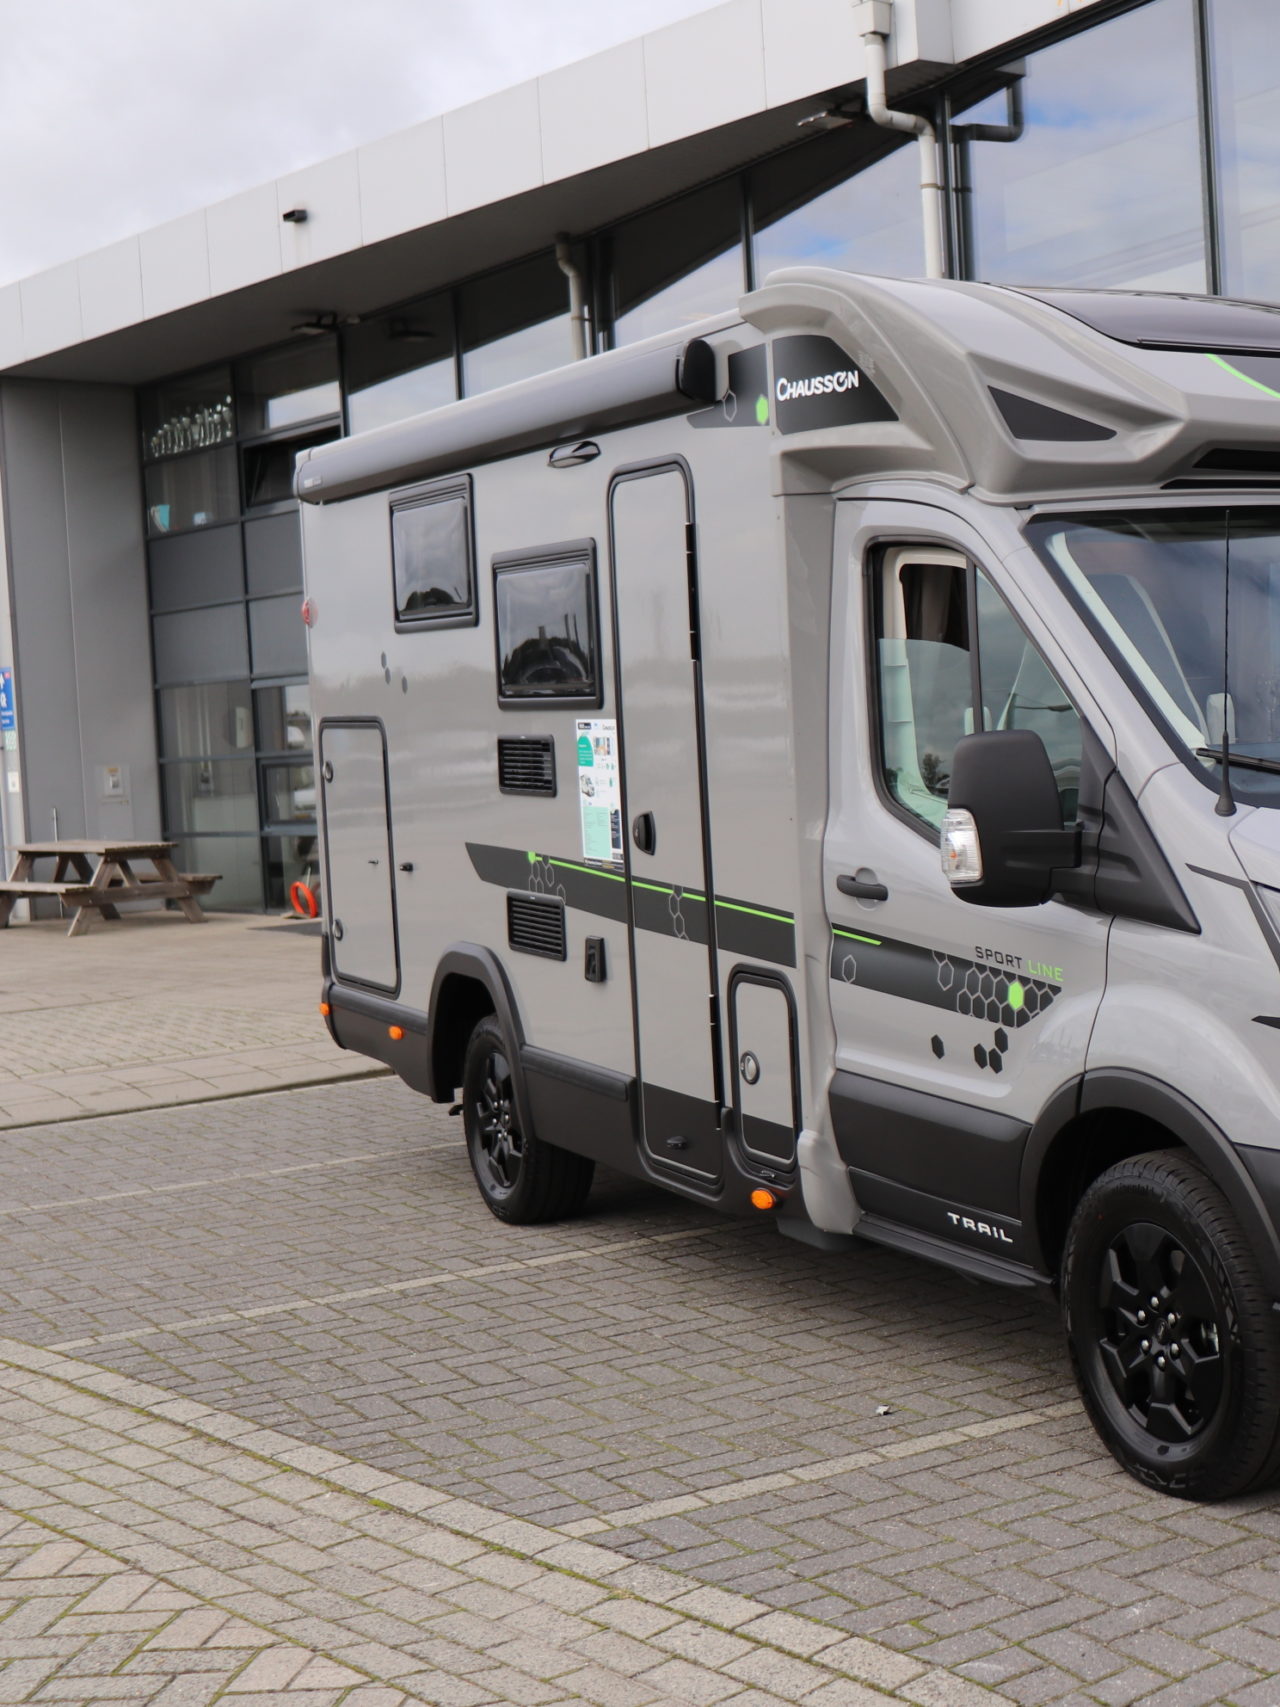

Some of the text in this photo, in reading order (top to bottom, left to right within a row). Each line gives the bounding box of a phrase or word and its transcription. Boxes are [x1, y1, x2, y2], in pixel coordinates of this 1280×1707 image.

[974, 945, 1064, 982] SPORT LINE
[946, 1211, 1014, 1244] TRAIL
